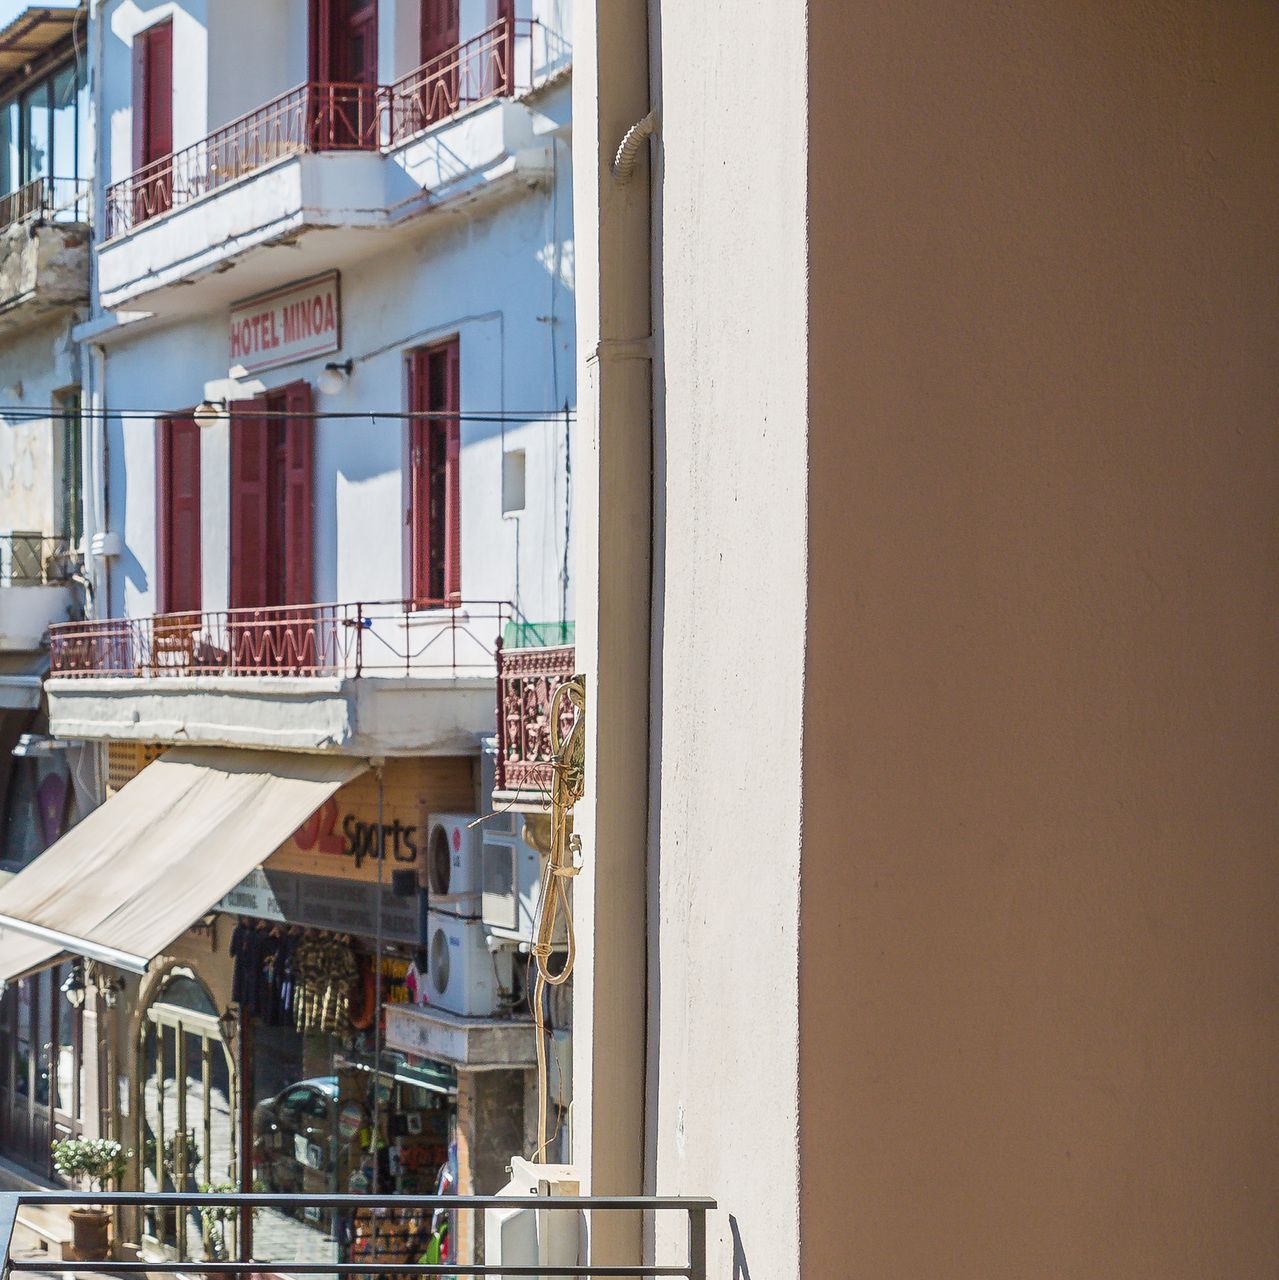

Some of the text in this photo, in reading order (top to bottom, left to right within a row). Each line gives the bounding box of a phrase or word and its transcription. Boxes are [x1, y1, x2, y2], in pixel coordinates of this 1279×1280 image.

[230, 292, 335, 358] HOTEL MINOA
[342, 812, 417, 869] Sports
